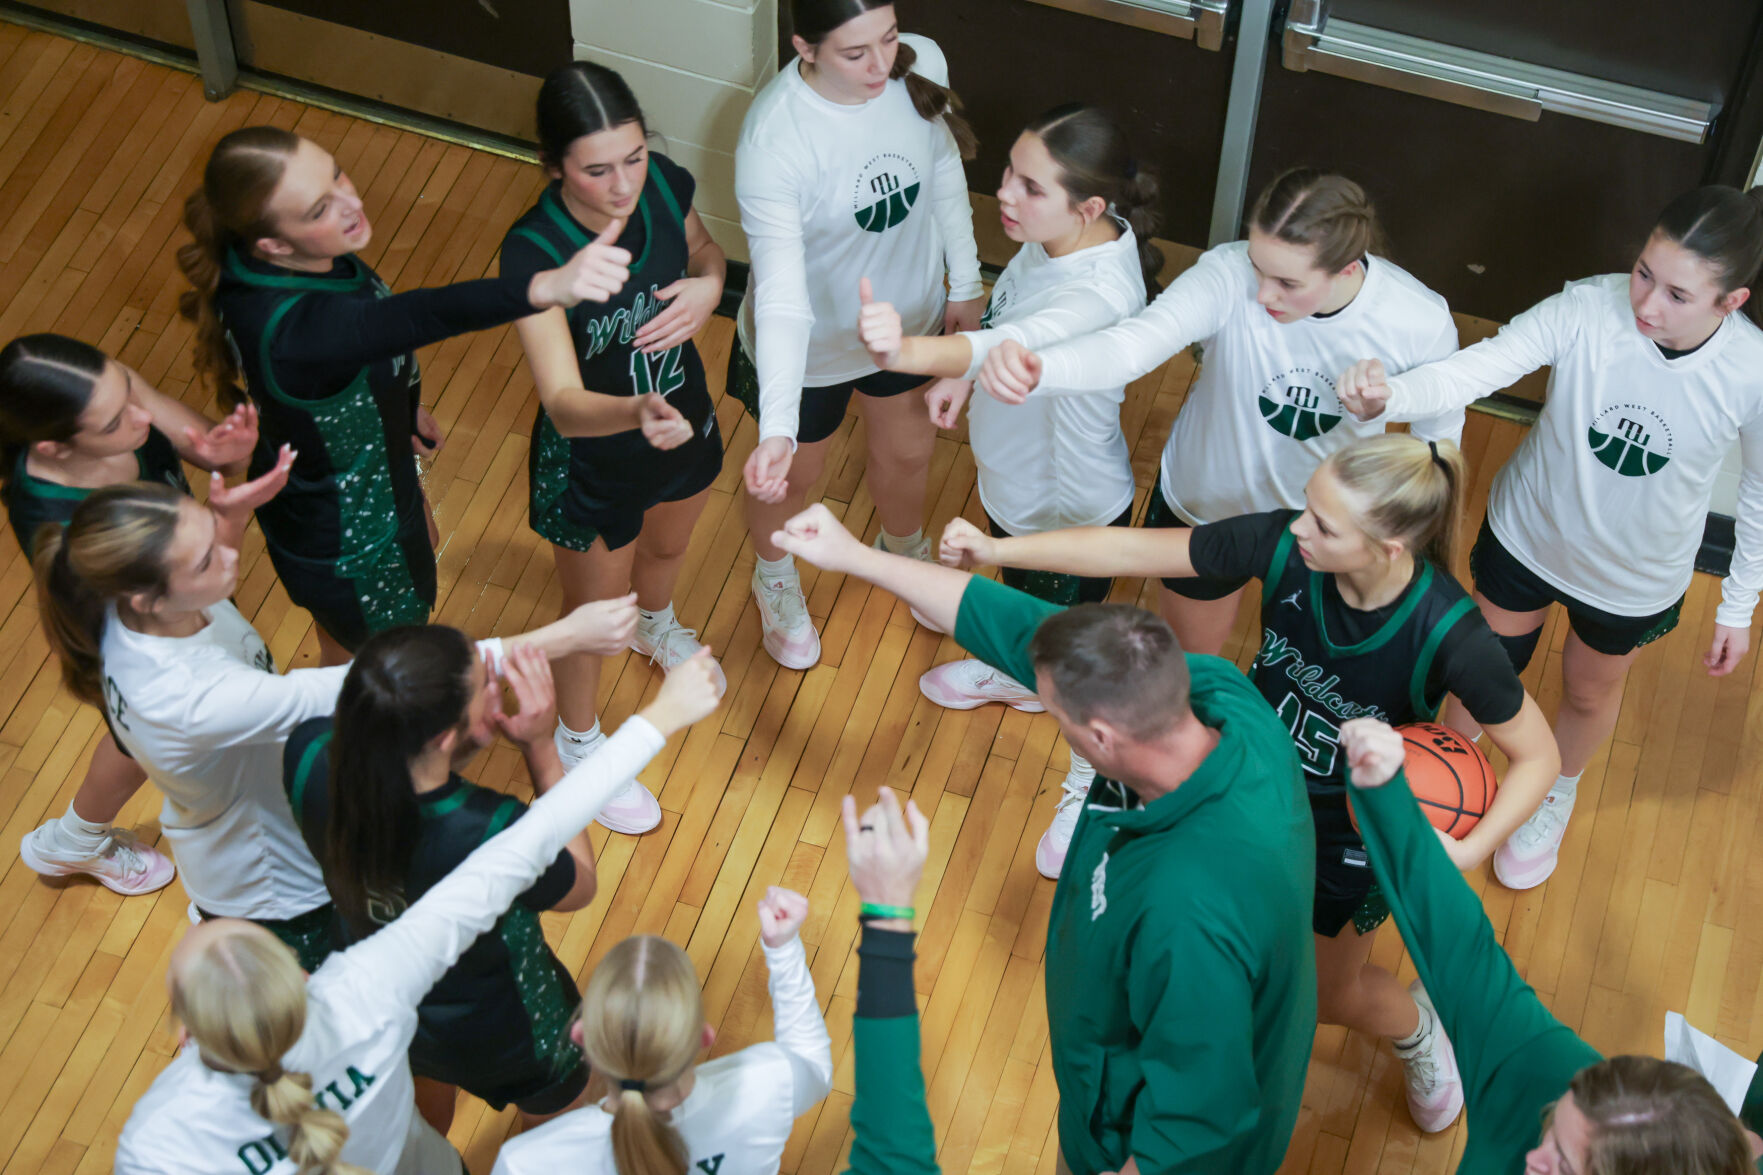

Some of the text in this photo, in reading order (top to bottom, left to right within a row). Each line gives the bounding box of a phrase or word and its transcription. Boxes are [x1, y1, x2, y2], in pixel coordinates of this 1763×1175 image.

[863, 154, 880, 170] WEST
[629, 344, 686, 397] 12
[1314, 370, 1344, 413] BASKEBALL
[1591, 402, 1674, 456] MILLARD WEST BASKETBALL
[1276, 690, 1342, 777] 15
